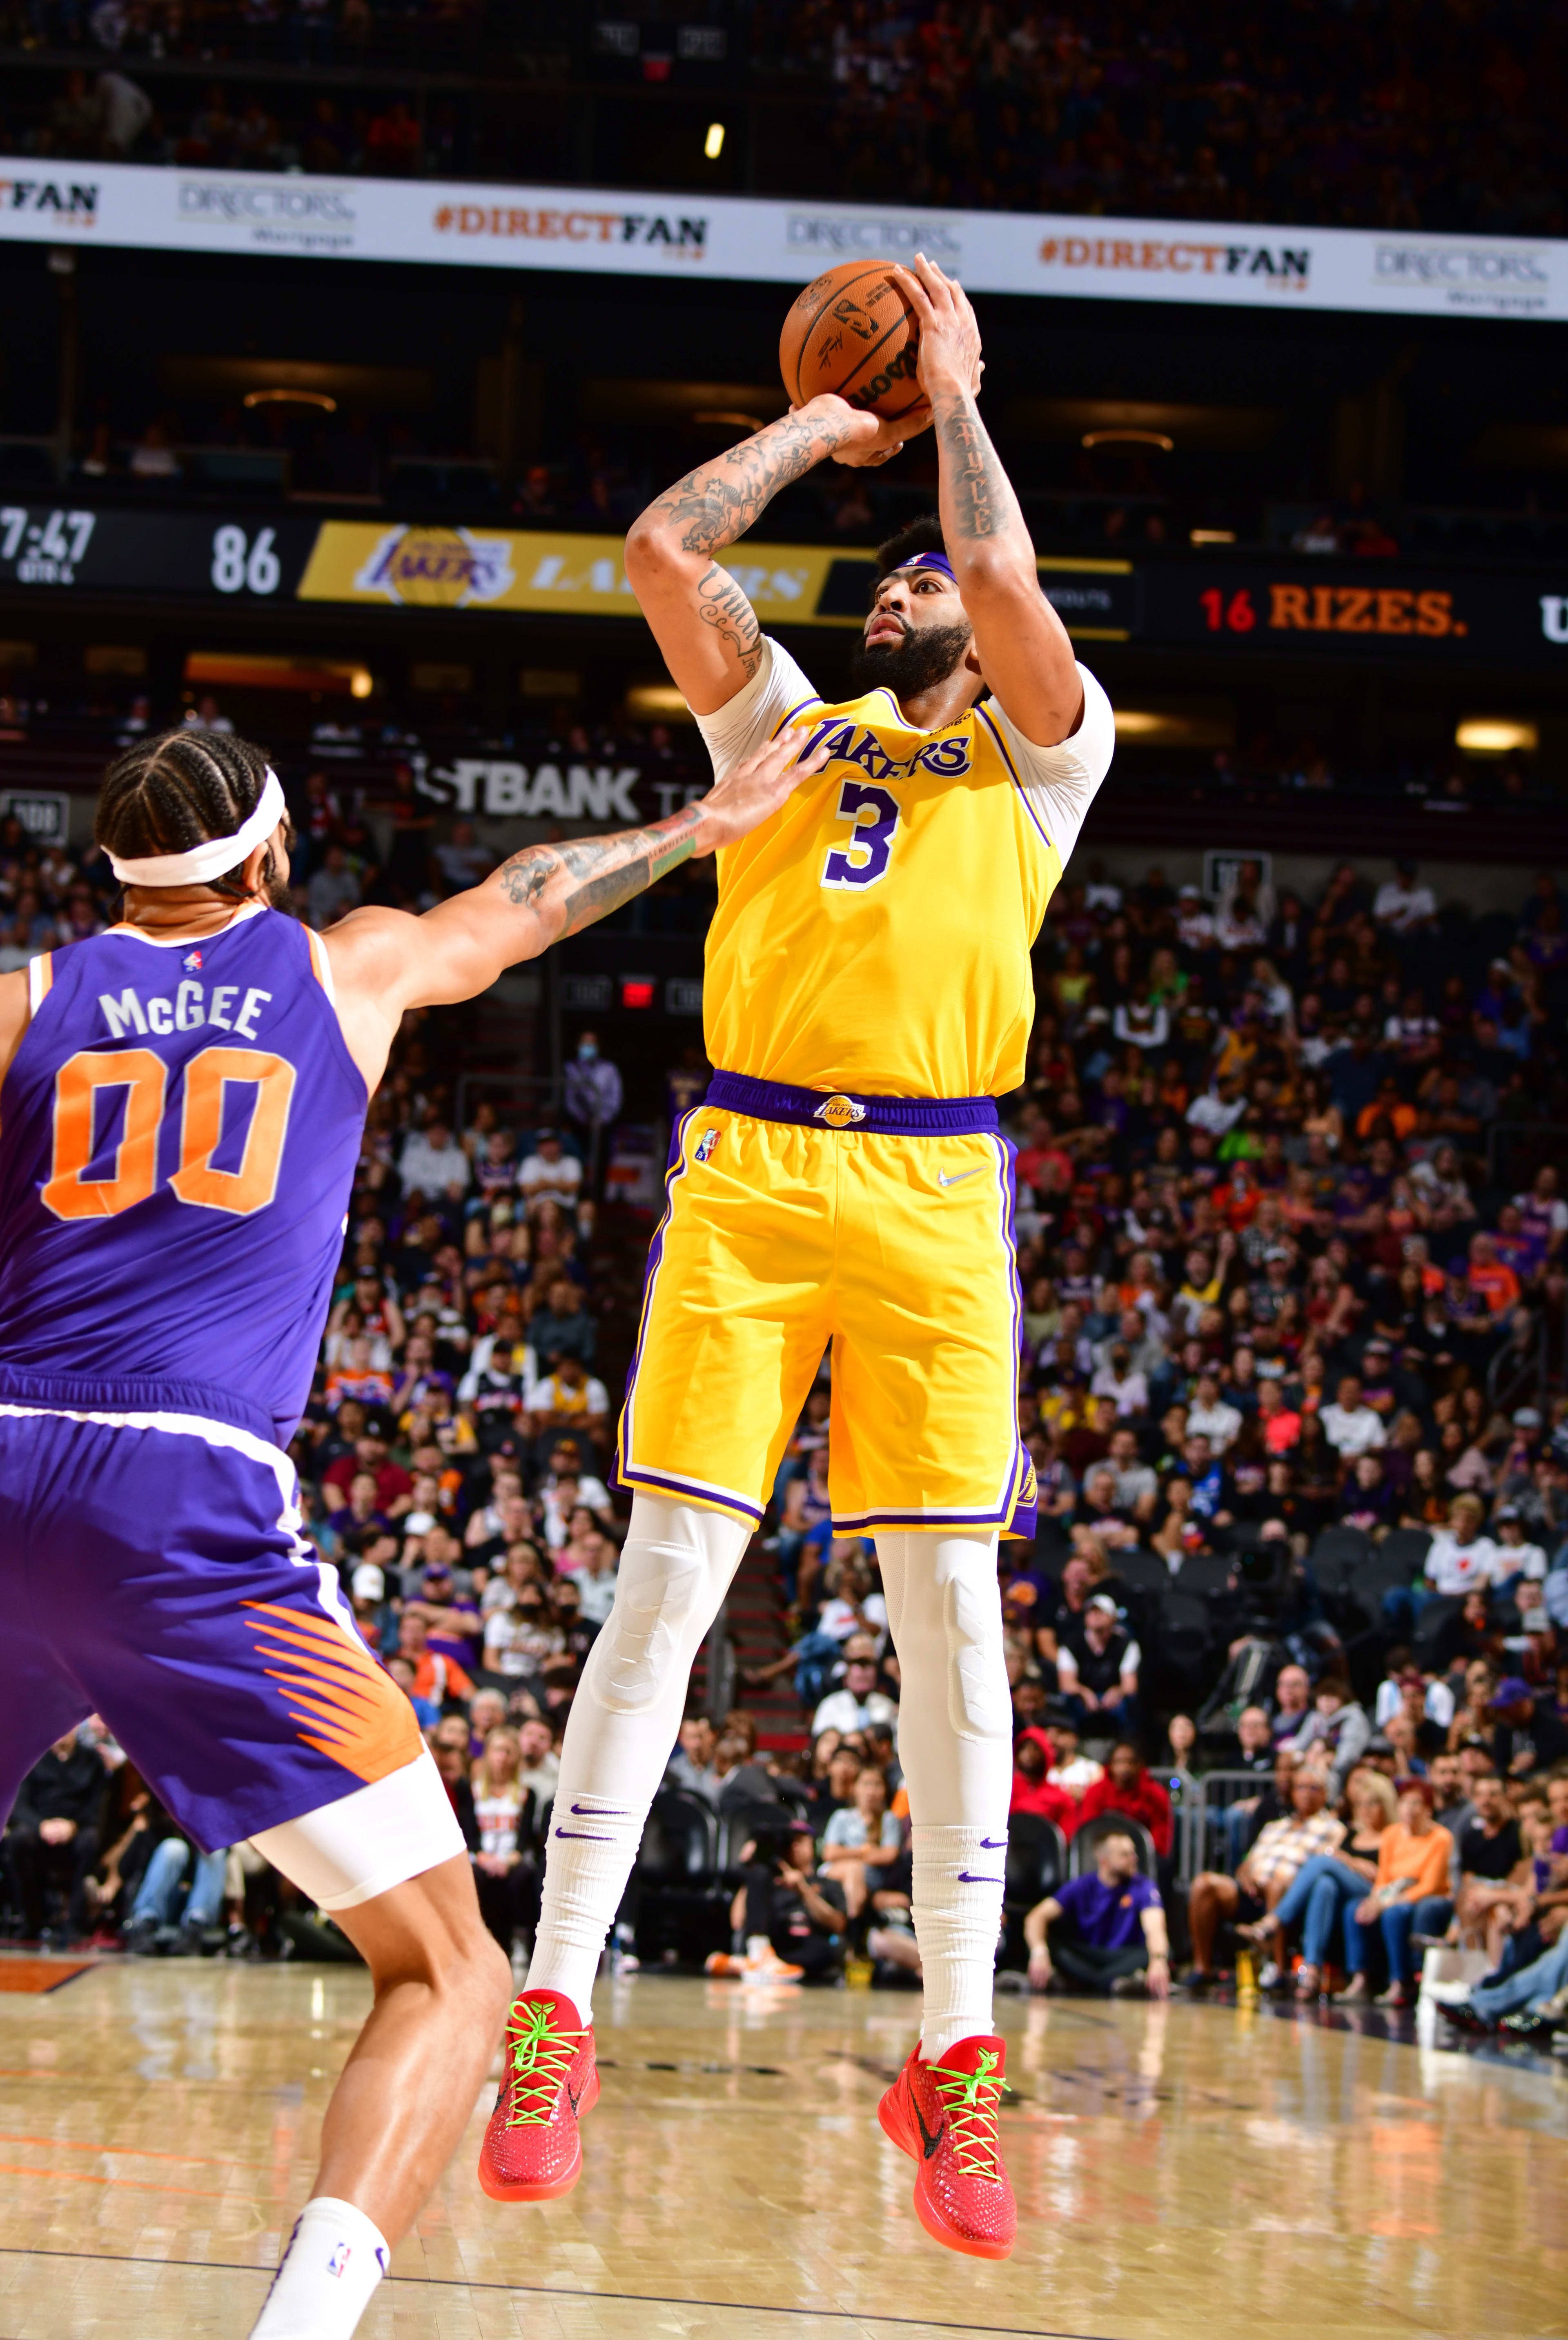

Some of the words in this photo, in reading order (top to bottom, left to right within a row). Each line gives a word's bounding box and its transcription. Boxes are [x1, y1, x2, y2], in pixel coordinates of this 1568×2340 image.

[434, 203, 707, 246] #DIRECTFAN
[1039, 236, 1309, 277] #DIRECTFAN
[211, 524, 281, 595] 86
[530, 554, 809, 603] LARS
[1199, 588, 1256, 634] 16
[1268, 584, 1468, 637] RIZES.
[820, 779, 902, 892] 3
[98, 980, 272, 1041] McGEE
[41, 1046, 297, 1222] 00
[816, 1103, 864, 1121] LAKERS
